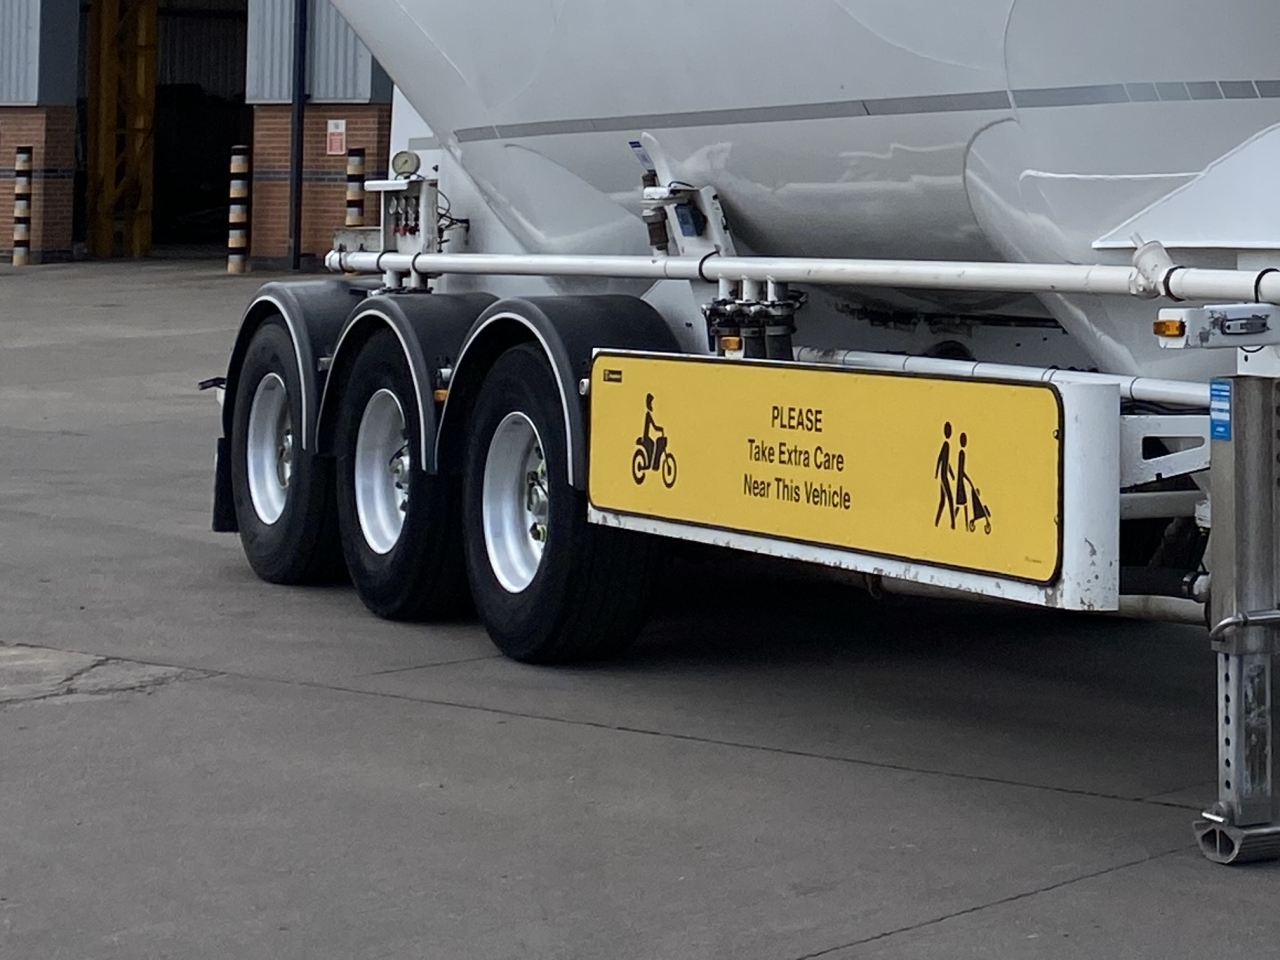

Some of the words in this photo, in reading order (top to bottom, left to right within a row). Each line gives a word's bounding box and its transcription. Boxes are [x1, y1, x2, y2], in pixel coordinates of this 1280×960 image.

[771, 405, 823, 433] PLEASE
[747, 438, 775, 464] Take
[778, 442, 811, 469] Extra
[813, 445, 845, 472] Care
[743, 473, 772, 499] Near
[774, 477, 801, 503] This
[804, 481, 851, 510] Vehicle
